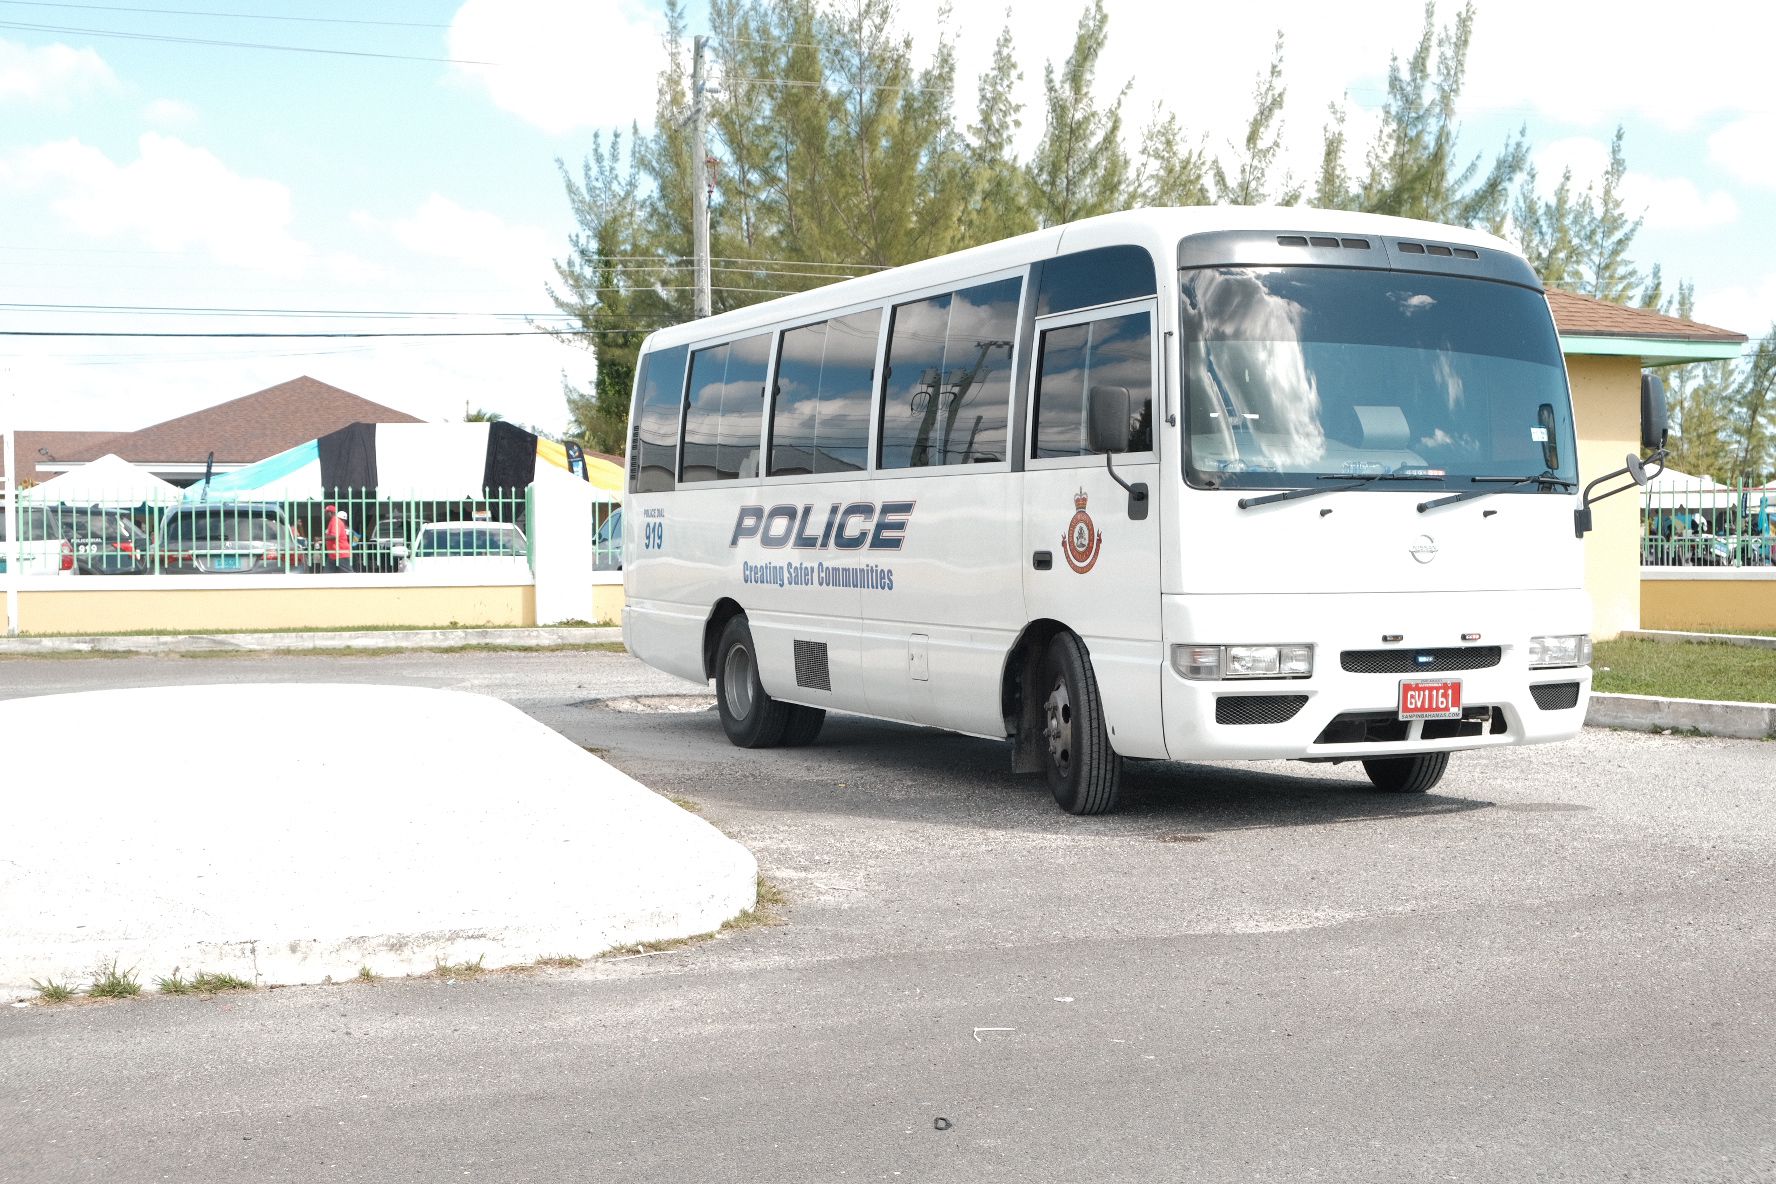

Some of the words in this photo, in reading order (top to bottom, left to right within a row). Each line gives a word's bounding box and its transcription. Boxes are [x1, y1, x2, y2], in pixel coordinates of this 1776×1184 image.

[643, 508, 656, 518] POLICE
[657, 508, 665, 518] DIAL
[729, 500, 916, 550] POLICE
[645, 521, 663, 550] 919
[78, 544, 97, 554] 919
[743, 560, 785, 588] Creating
[787, 561, 814, 586] Safer
[817, 561, 894, 591] Communities
[1407, 689, 1452, 709] GV1161
